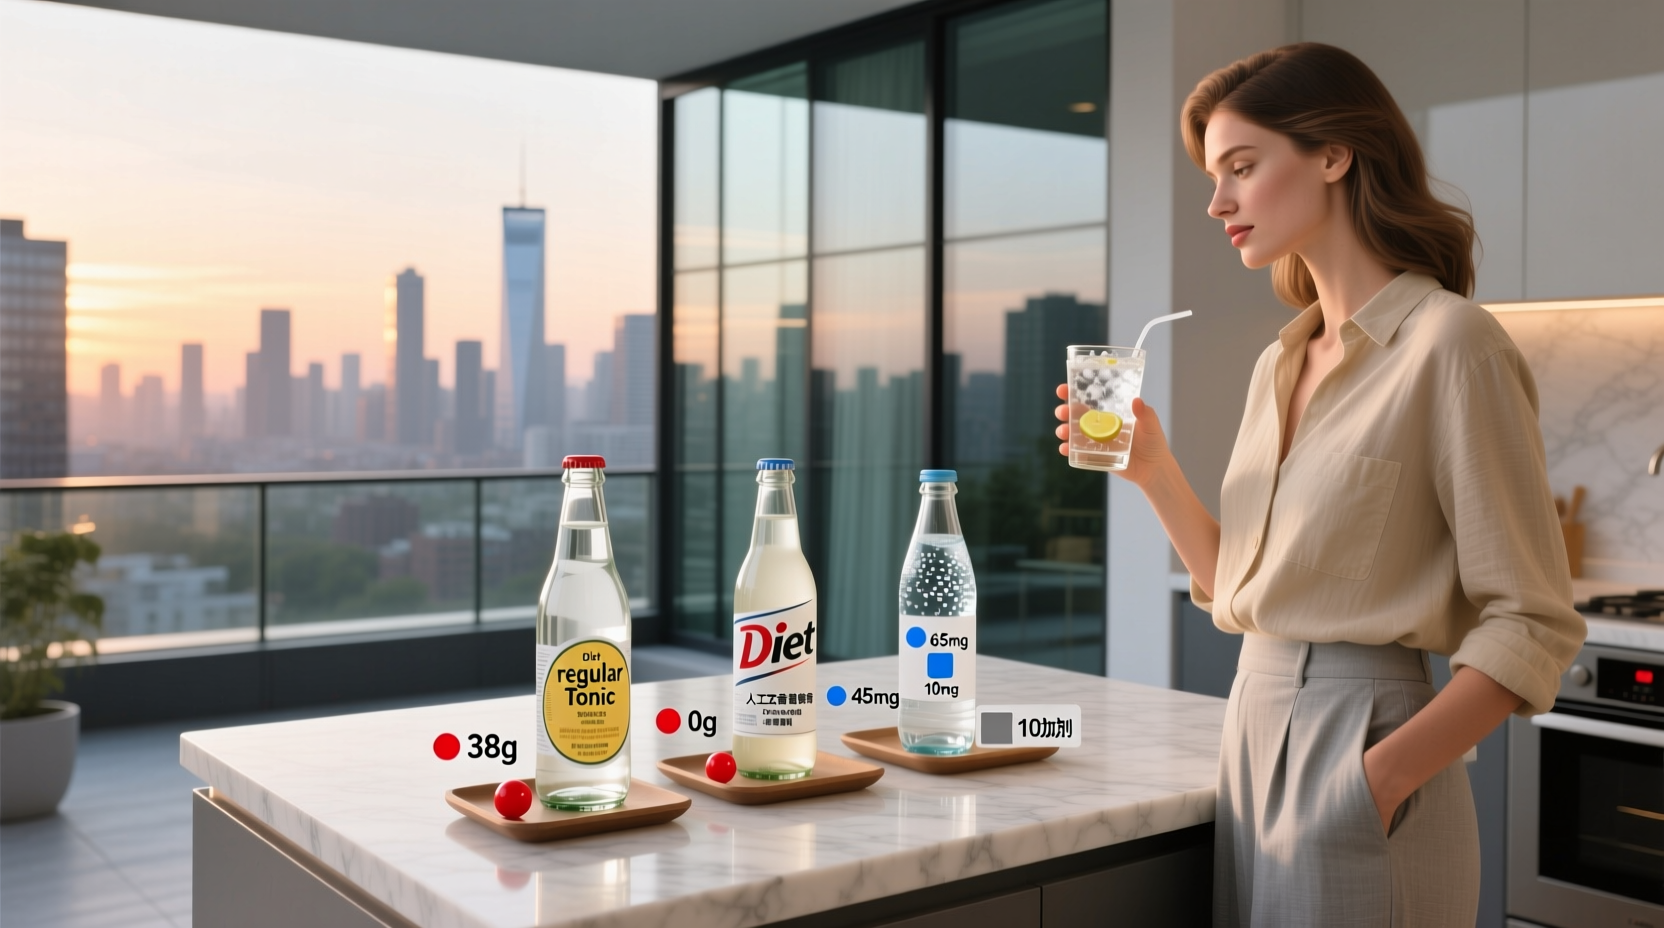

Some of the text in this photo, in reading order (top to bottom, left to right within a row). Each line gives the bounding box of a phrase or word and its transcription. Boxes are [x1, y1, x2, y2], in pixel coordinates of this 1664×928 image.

[740, 621, 815, 669] Diet
[930, 632, 968, 651] 65mg
[557, 662, 623, 689] regular
[564, 687, 616, 706] Tonic
